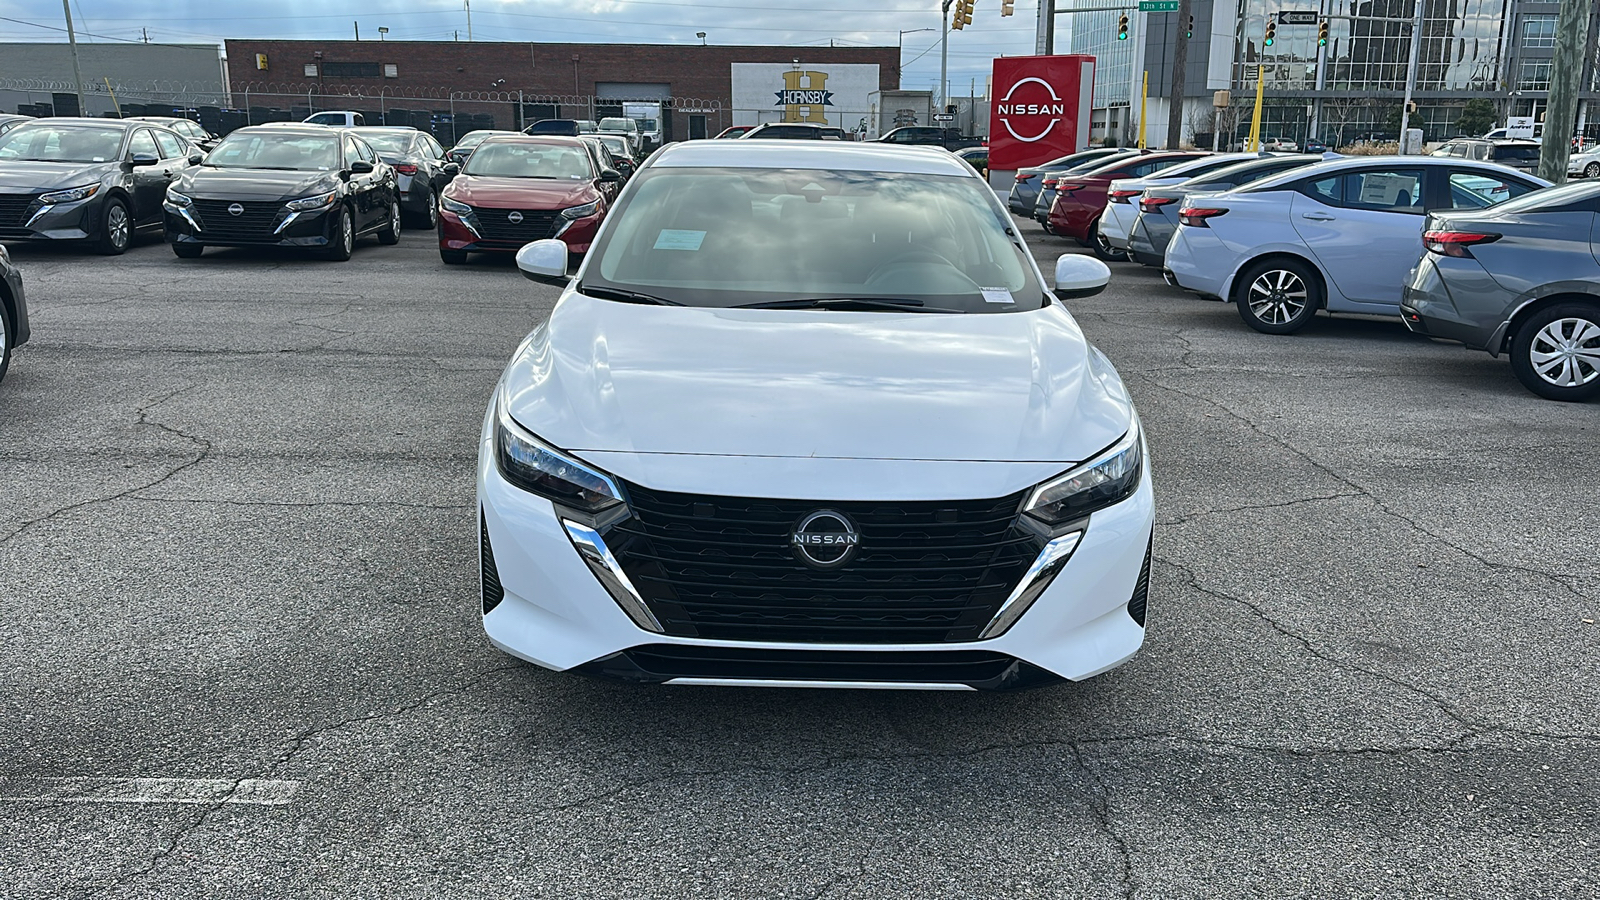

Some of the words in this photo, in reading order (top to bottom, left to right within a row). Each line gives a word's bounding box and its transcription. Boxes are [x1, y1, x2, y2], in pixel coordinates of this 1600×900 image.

[783, 91, 826, 104] HORNSBY
[998, 104, 1064, 115] NISSAN
[794, 534, 857, 544] NISSAN
